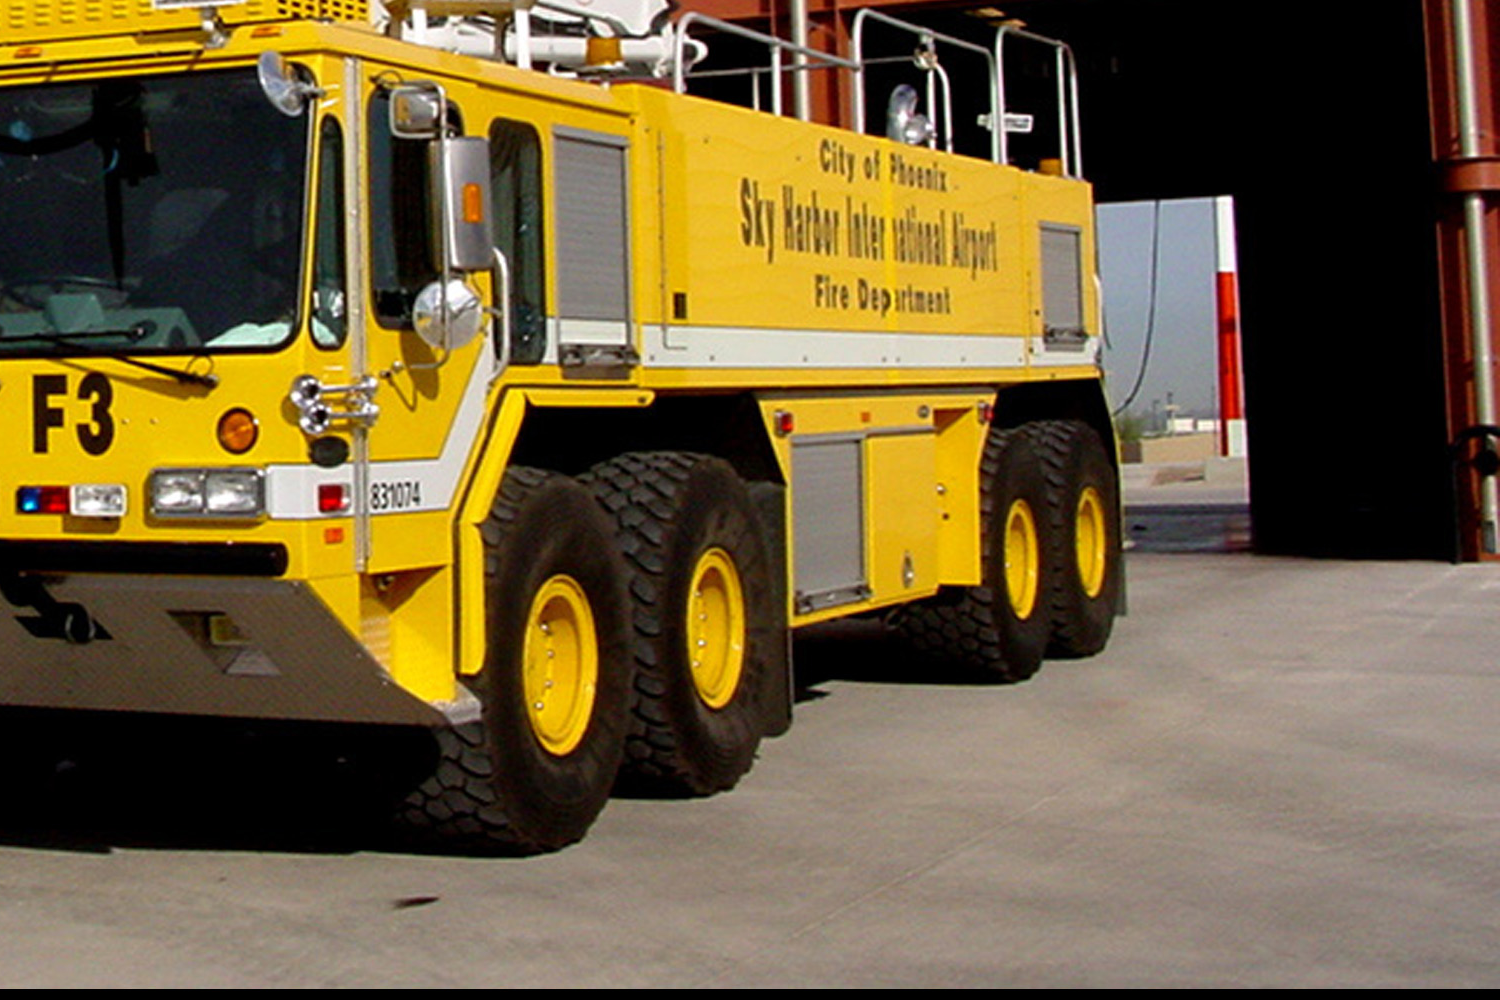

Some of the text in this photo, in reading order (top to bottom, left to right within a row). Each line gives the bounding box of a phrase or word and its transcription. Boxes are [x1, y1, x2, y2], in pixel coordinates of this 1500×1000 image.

[819, 138, 947, 192] City of Phoenix
[740, 176, 775, 264] Sky
[782, 184, 839, 256] Harbor
[952, 211, 998, 280] Airport
[815, 273, 951, 318] Fire Department
[370, 481, 421, 510] 831074
